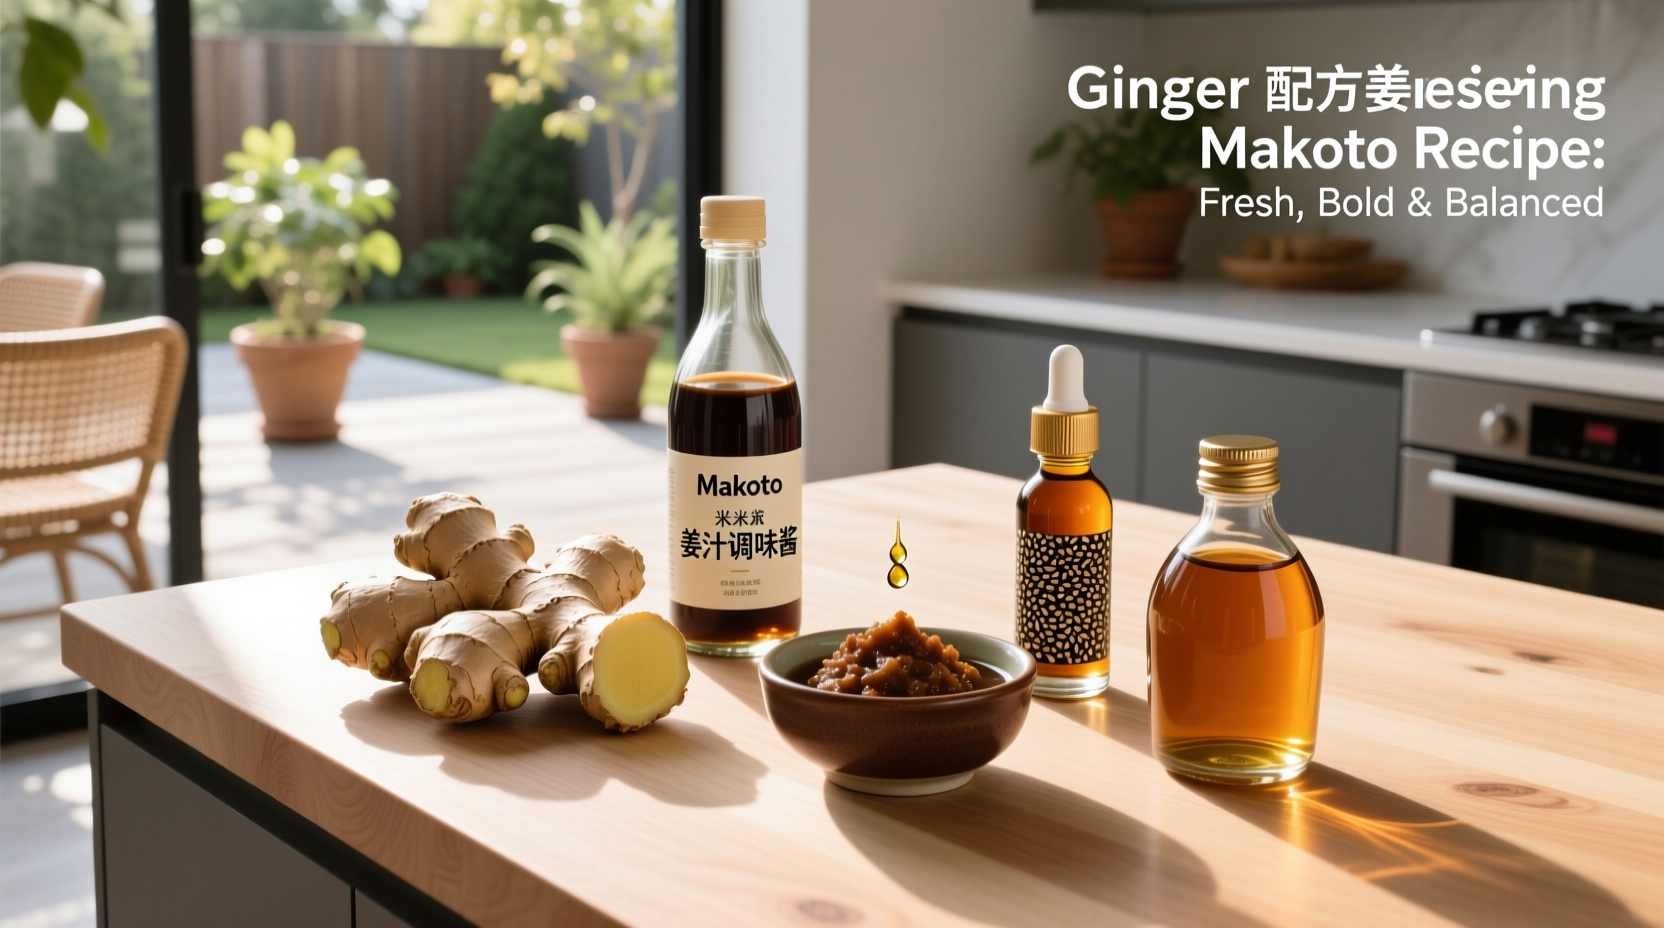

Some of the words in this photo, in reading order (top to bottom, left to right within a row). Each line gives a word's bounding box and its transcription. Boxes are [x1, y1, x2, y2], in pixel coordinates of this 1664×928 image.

[697, 473, 783, 497] Makoto
[680, 525, 798, 561] 姜汁调味酱
